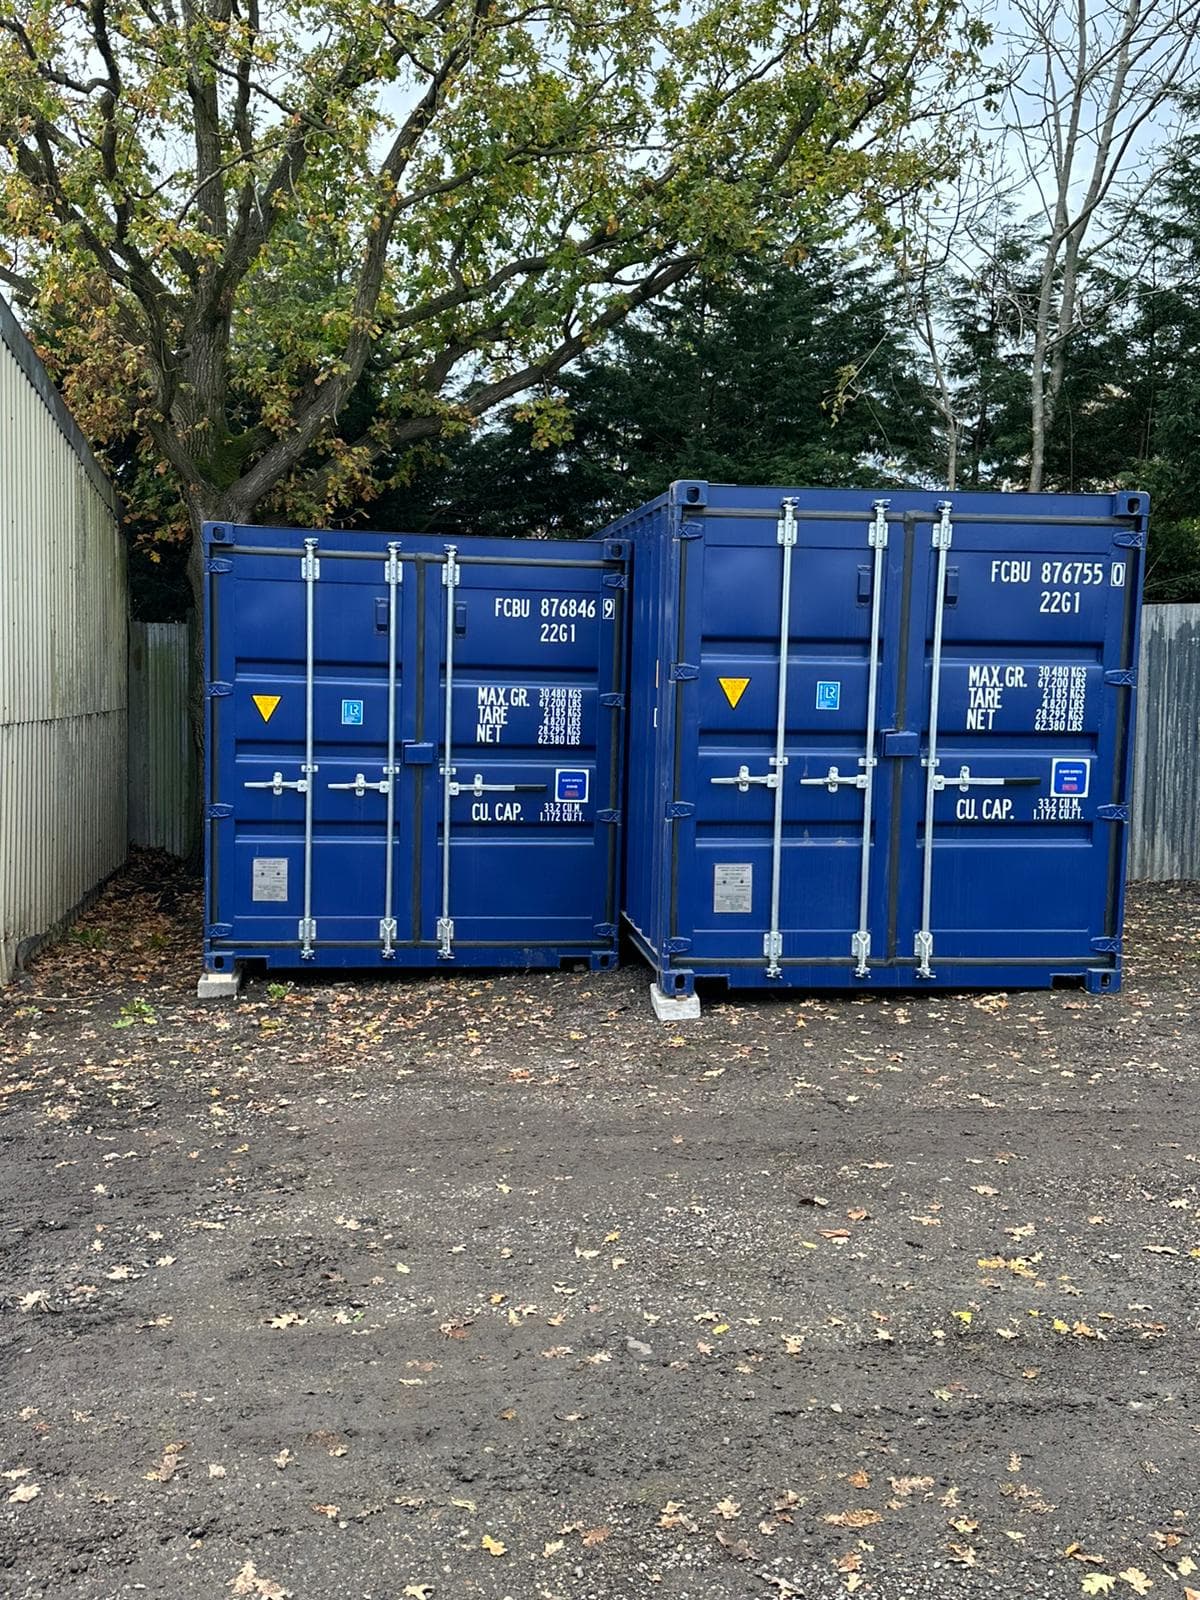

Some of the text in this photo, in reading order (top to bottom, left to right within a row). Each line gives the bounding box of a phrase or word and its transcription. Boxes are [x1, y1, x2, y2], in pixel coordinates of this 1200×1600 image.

[991, 560, 1031, 583] FCBU
[1041, 562, 1103, 584] 876755
[1040, 591, 1080, 613] 22G1
[495, 598, 614, 619] FCBU 876846 9
[541, 623, 576, 643] 22G1
[1038, 666, 1087, 677] 30.480 KGS
[1037, 677, 1086, 688] 67.200 LBS
[539, 688, 583, 699] 30.480 KGS
[968, 687, 1003, 709] TARE
[1042, 688, 1086, 699] 2.185 KGS
[568, 699, 582, 709] LBS
[1041, 699, 1084, 710] 4.820 LBS
[478, 706, 508, 725] TARE
[567, 708, 582, 718] KGS
[966, 708, 995, 730] NET
[1035, 709, 1084, 721] 28.295 KGS
[567, 718, 581, 727] LBS
[1034, 720, 1083, 732] 62.380 LBS
[476, 724, 502, 743] NET
[566, 727, 581, 736] KGS
[566, 736, 581, 746] LBS
[472, 803, 524, 822] CU. CAP.
[956, 799, 1015, 820] CU. CAP.
